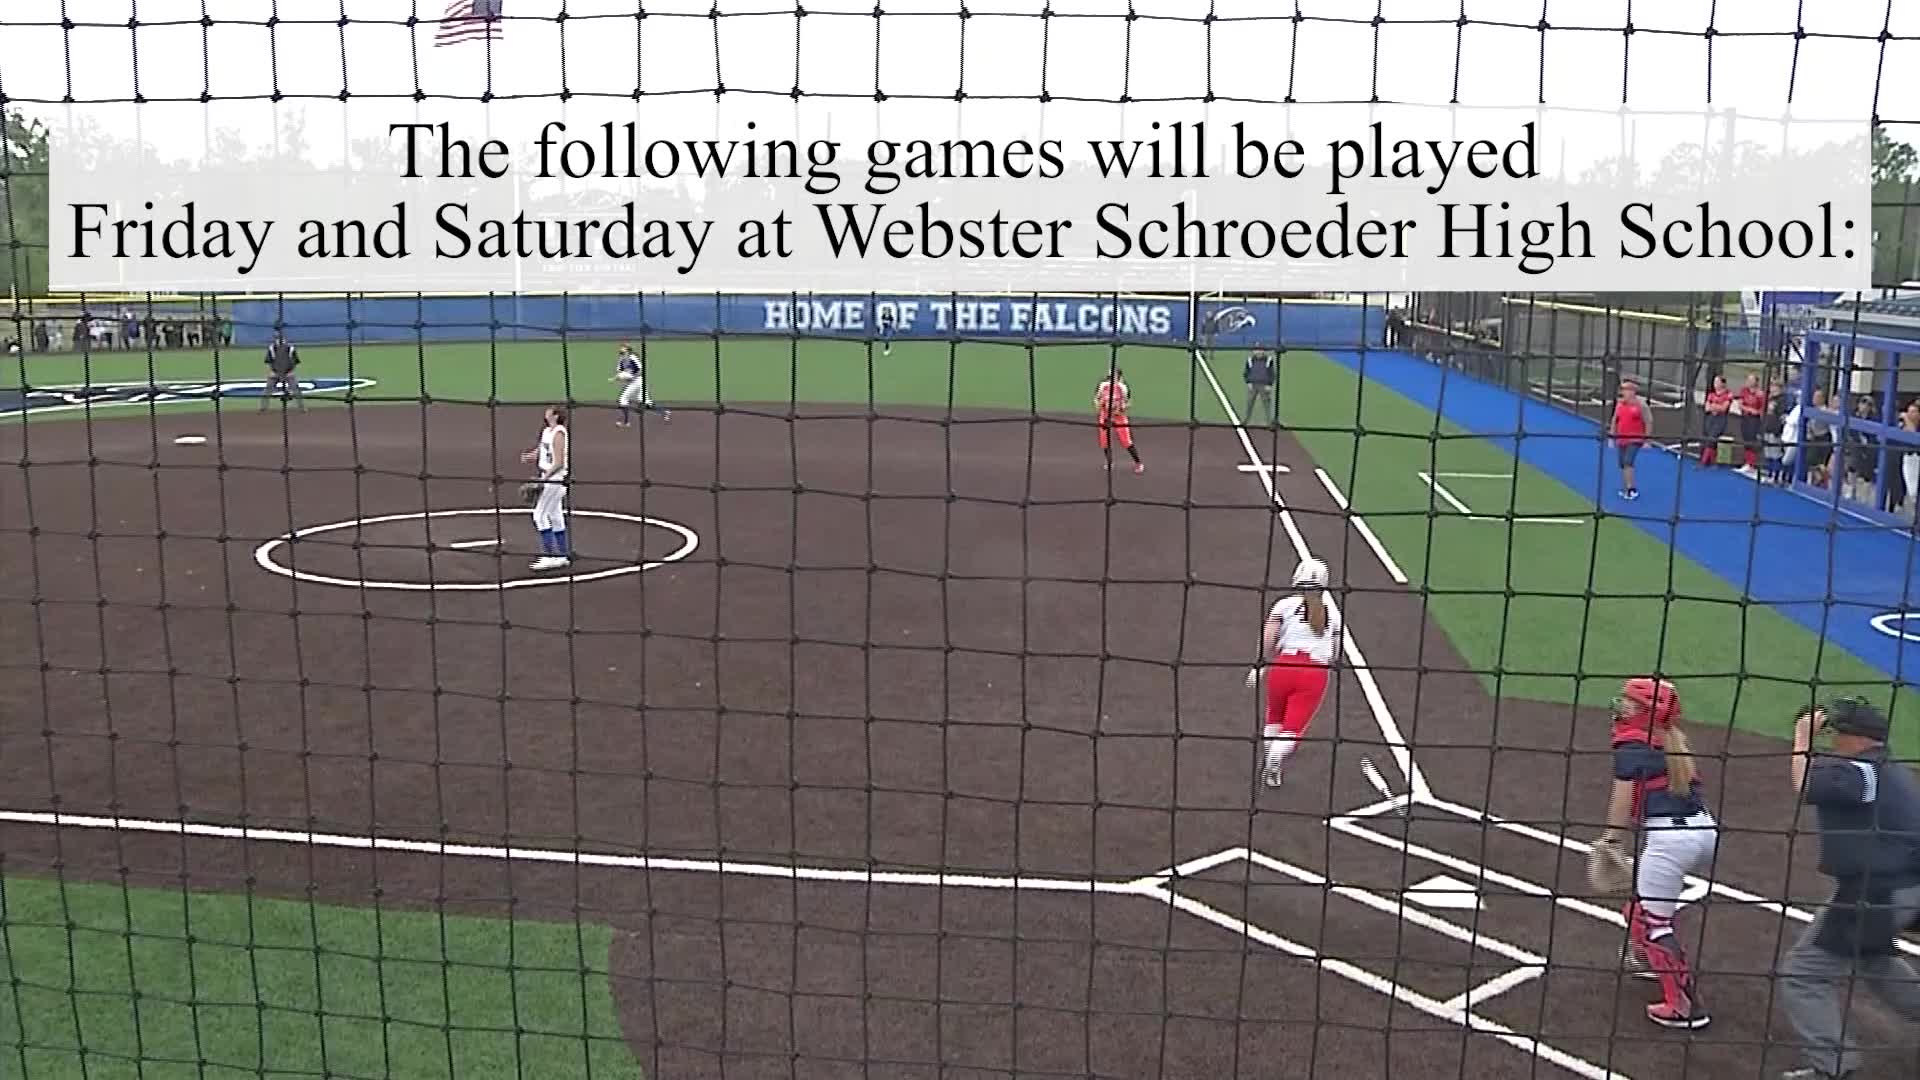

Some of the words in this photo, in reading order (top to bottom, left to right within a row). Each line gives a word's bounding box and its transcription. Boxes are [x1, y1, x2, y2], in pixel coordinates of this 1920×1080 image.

[764, 301, 865, 330] HOME
[877, 301, 919, 331] OF
[930, 302, 1000, 332] THE
[1010, 302, 1171, 335] FALCONS
